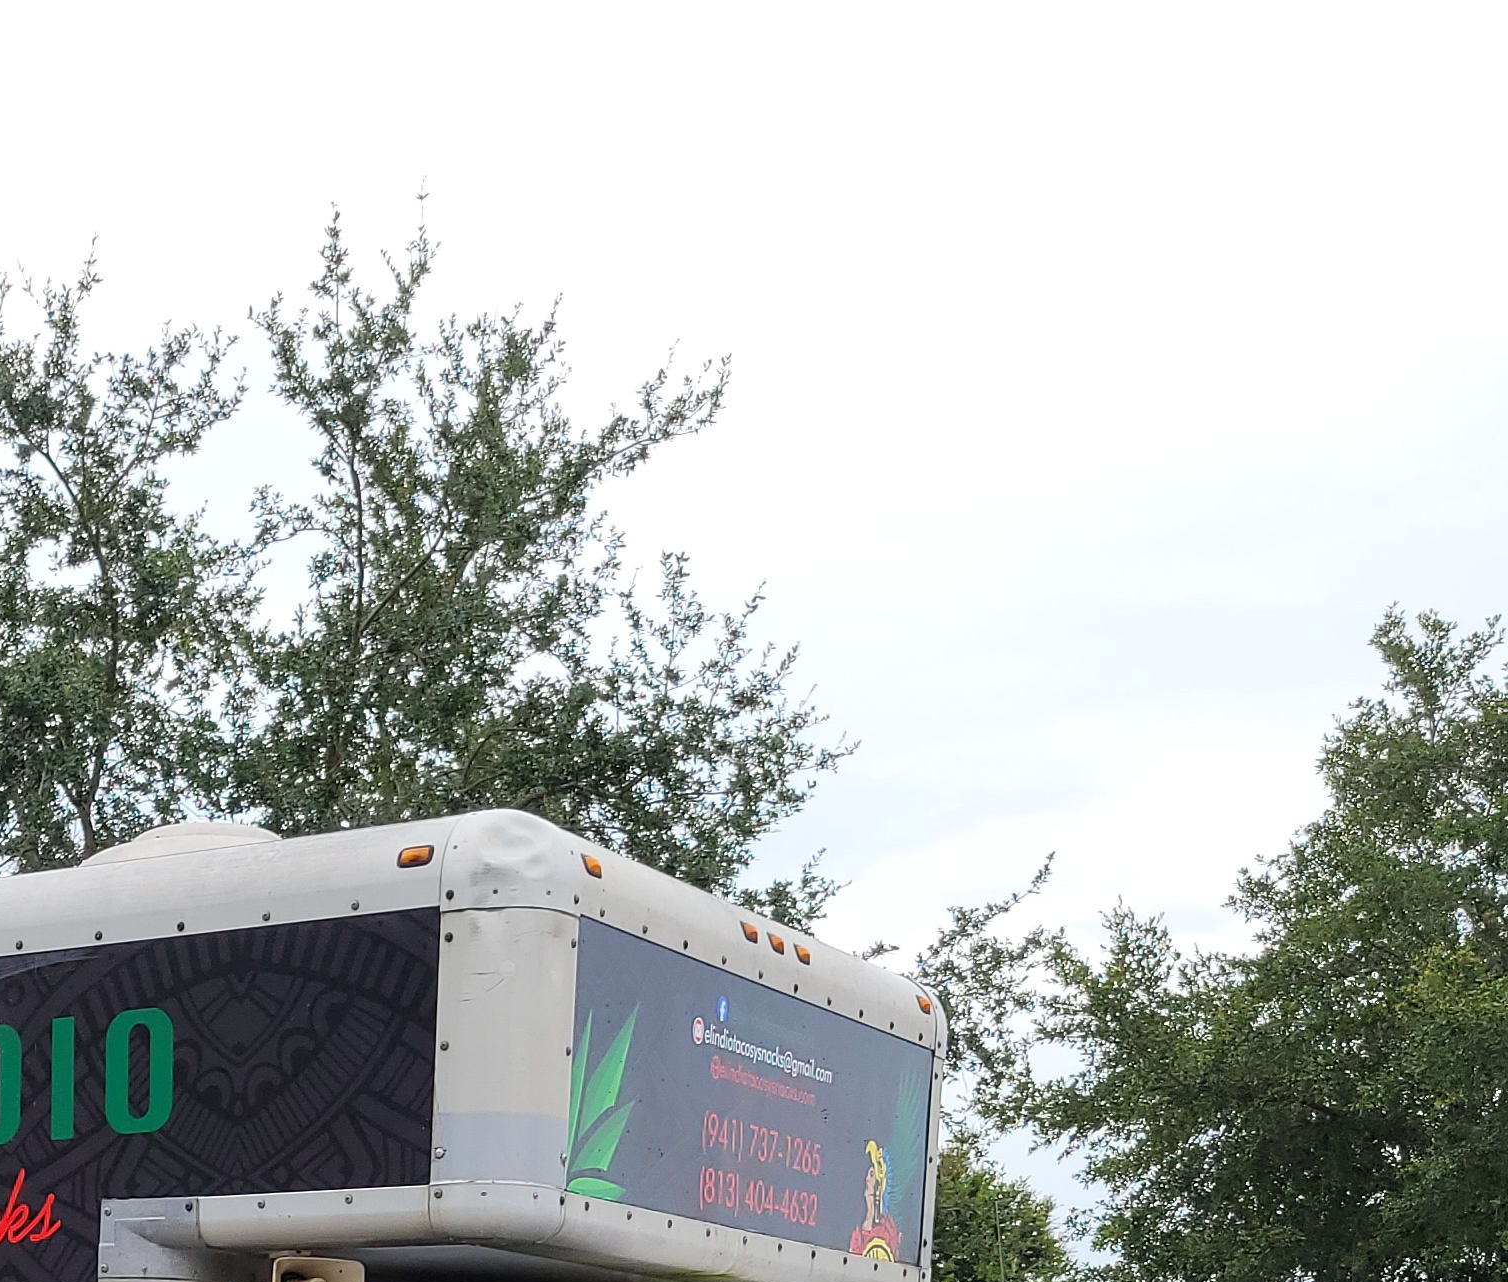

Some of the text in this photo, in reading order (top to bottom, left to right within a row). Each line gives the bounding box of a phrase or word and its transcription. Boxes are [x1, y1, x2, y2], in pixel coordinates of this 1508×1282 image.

[704, 1023, 832, 1084] elindiotacosysnacks@gmail.com
[702, 1110, 821, 1176] (941) 737-1265
[700, 1166, 817, 1226] (813) 404-4632
